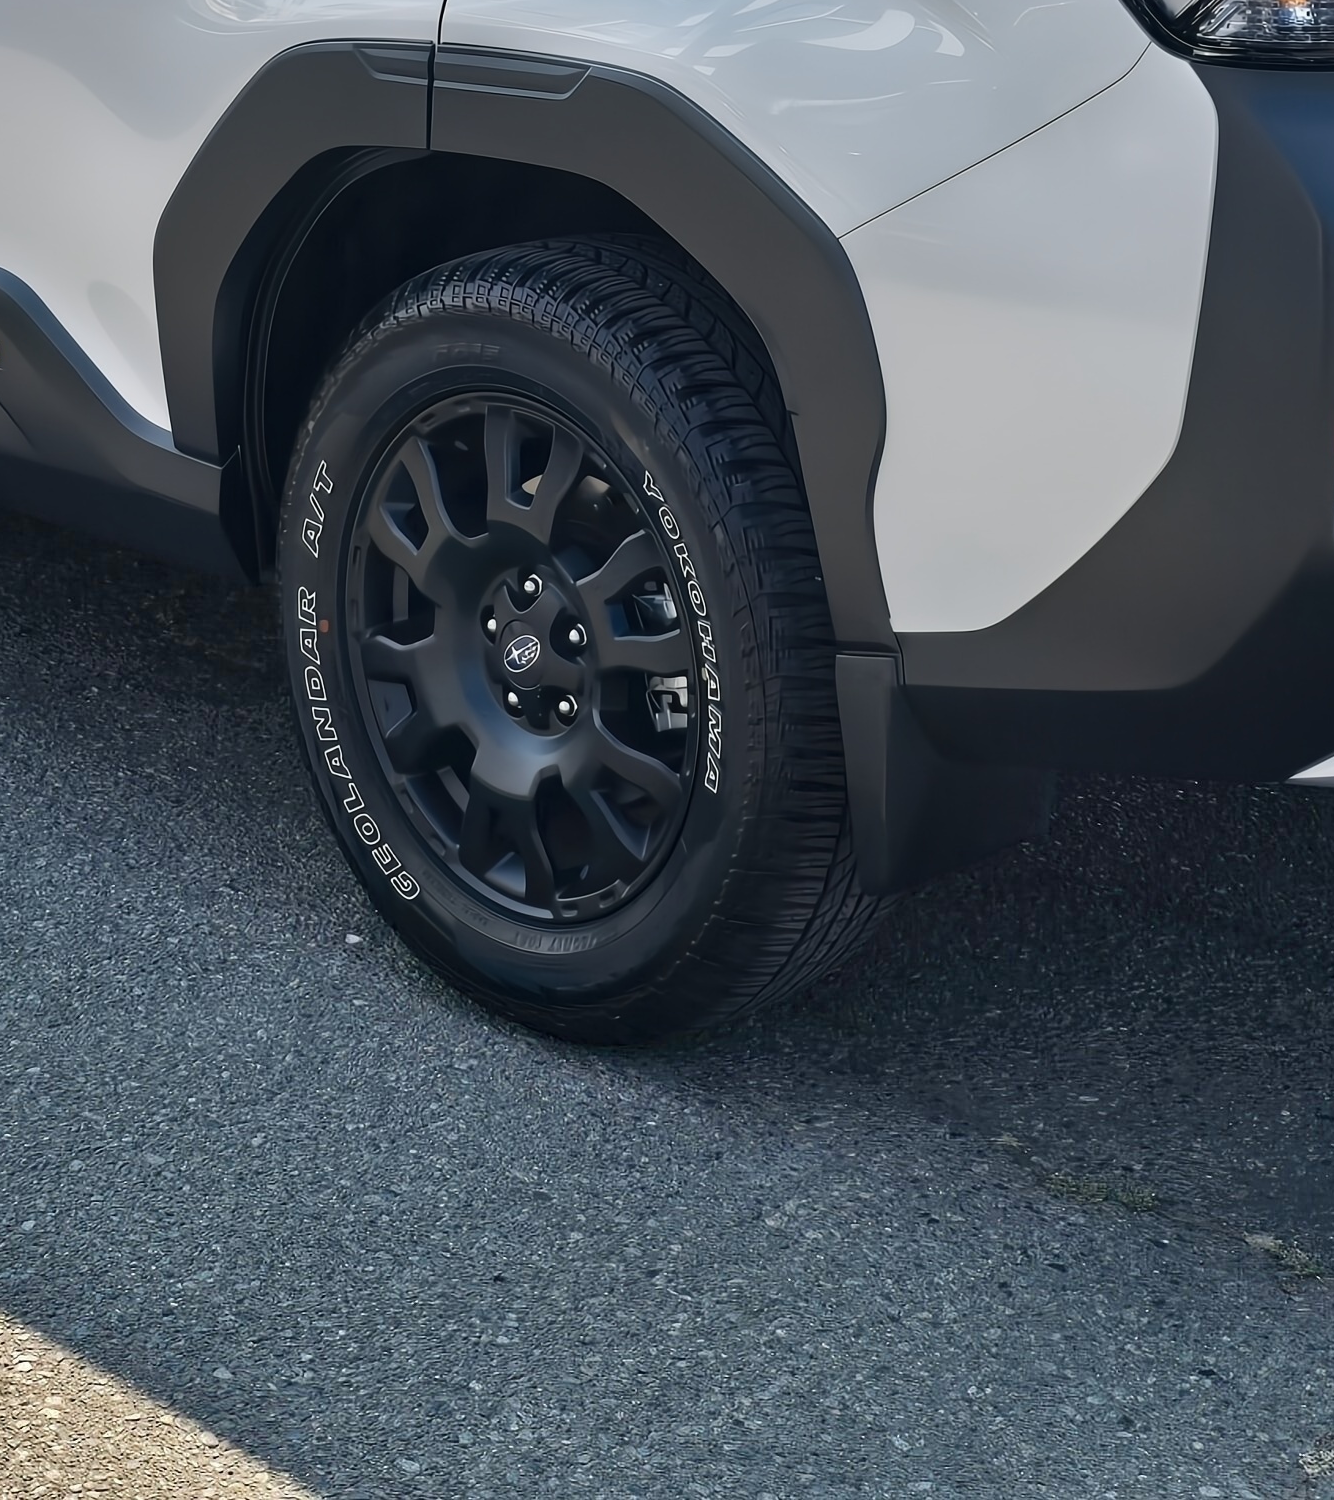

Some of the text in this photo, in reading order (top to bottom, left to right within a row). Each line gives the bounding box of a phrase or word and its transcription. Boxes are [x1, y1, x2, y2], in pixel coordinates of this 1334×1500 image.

[297, 460, 421, 900] GEOLANDAR A/T
[642, 469, 723, 794] YOKOHAMA
